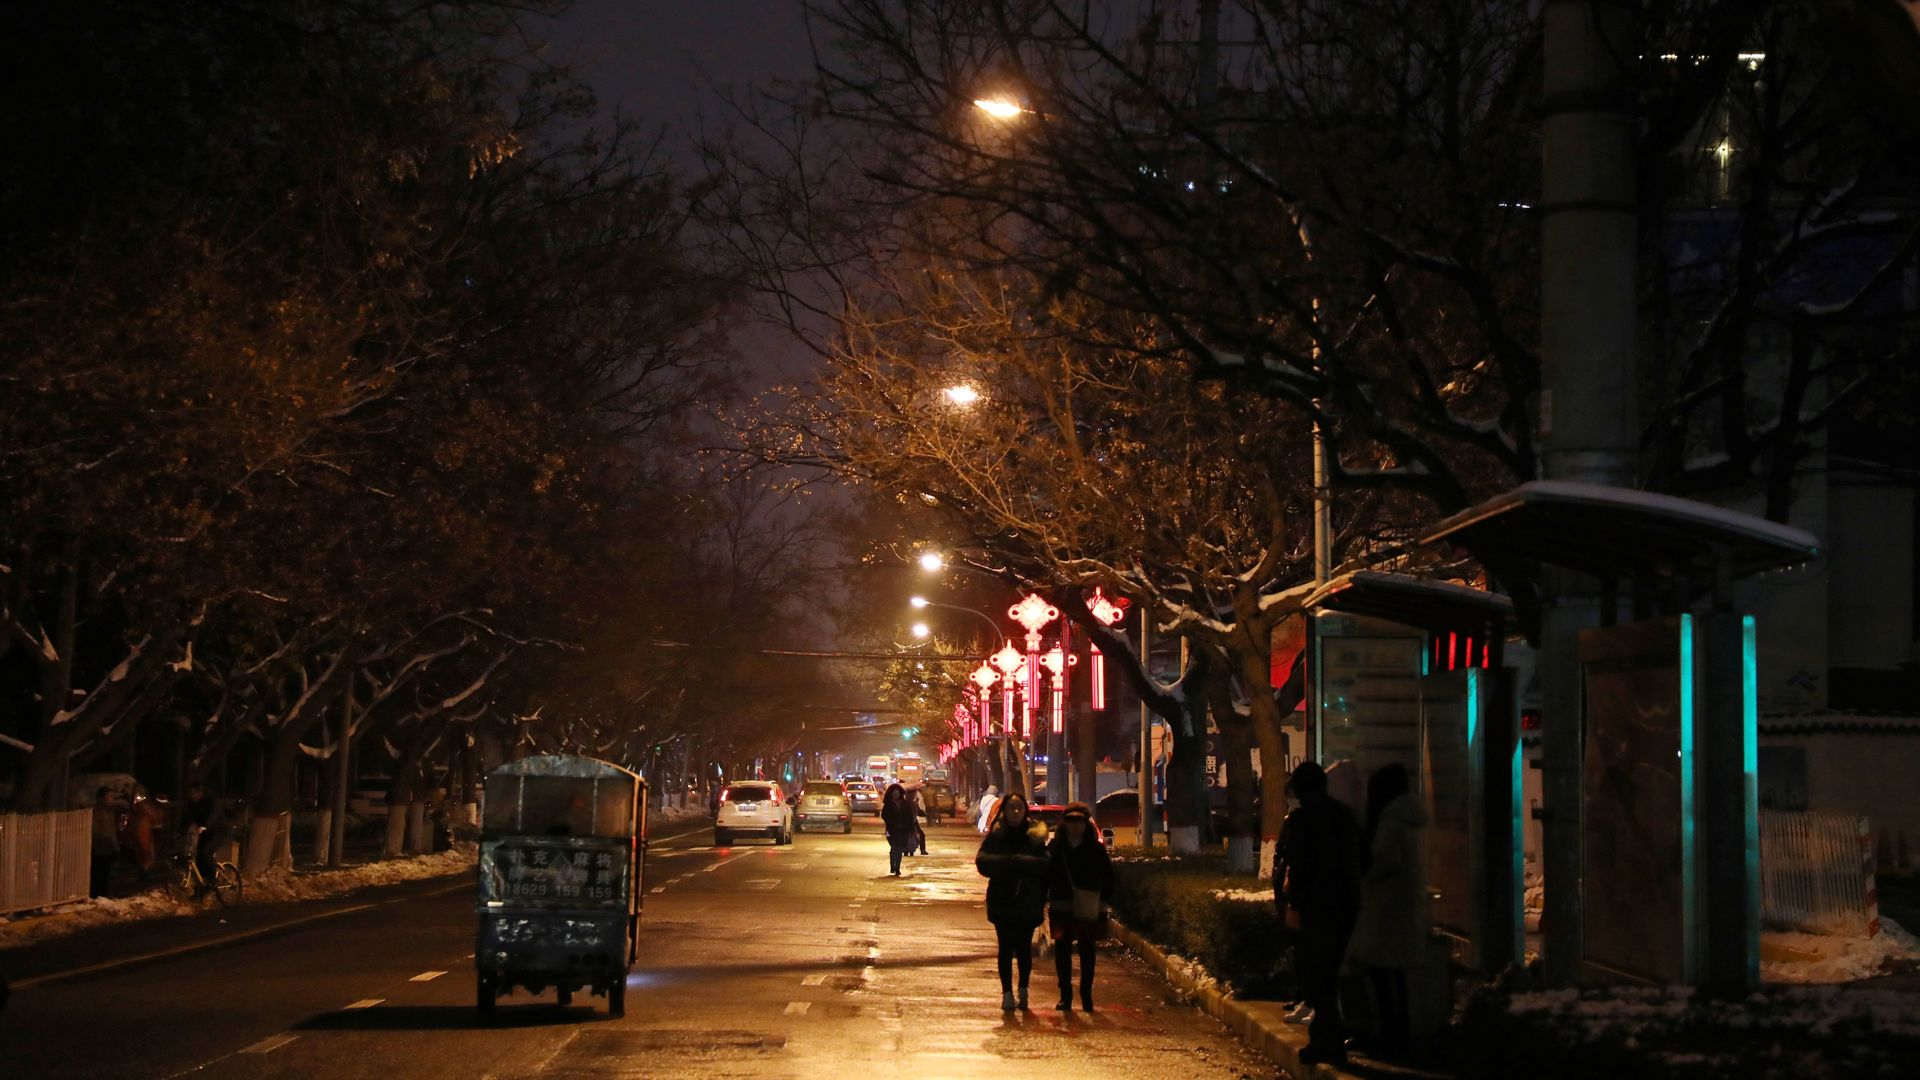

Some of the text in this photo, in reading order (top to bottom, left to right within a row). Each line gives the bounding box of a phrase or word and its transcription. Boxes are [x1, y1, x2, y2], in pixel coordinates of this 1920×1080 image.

[509, 849, 612, 868] 扑克 麻将
[505, 883, 613, 898] 18629 159 159
